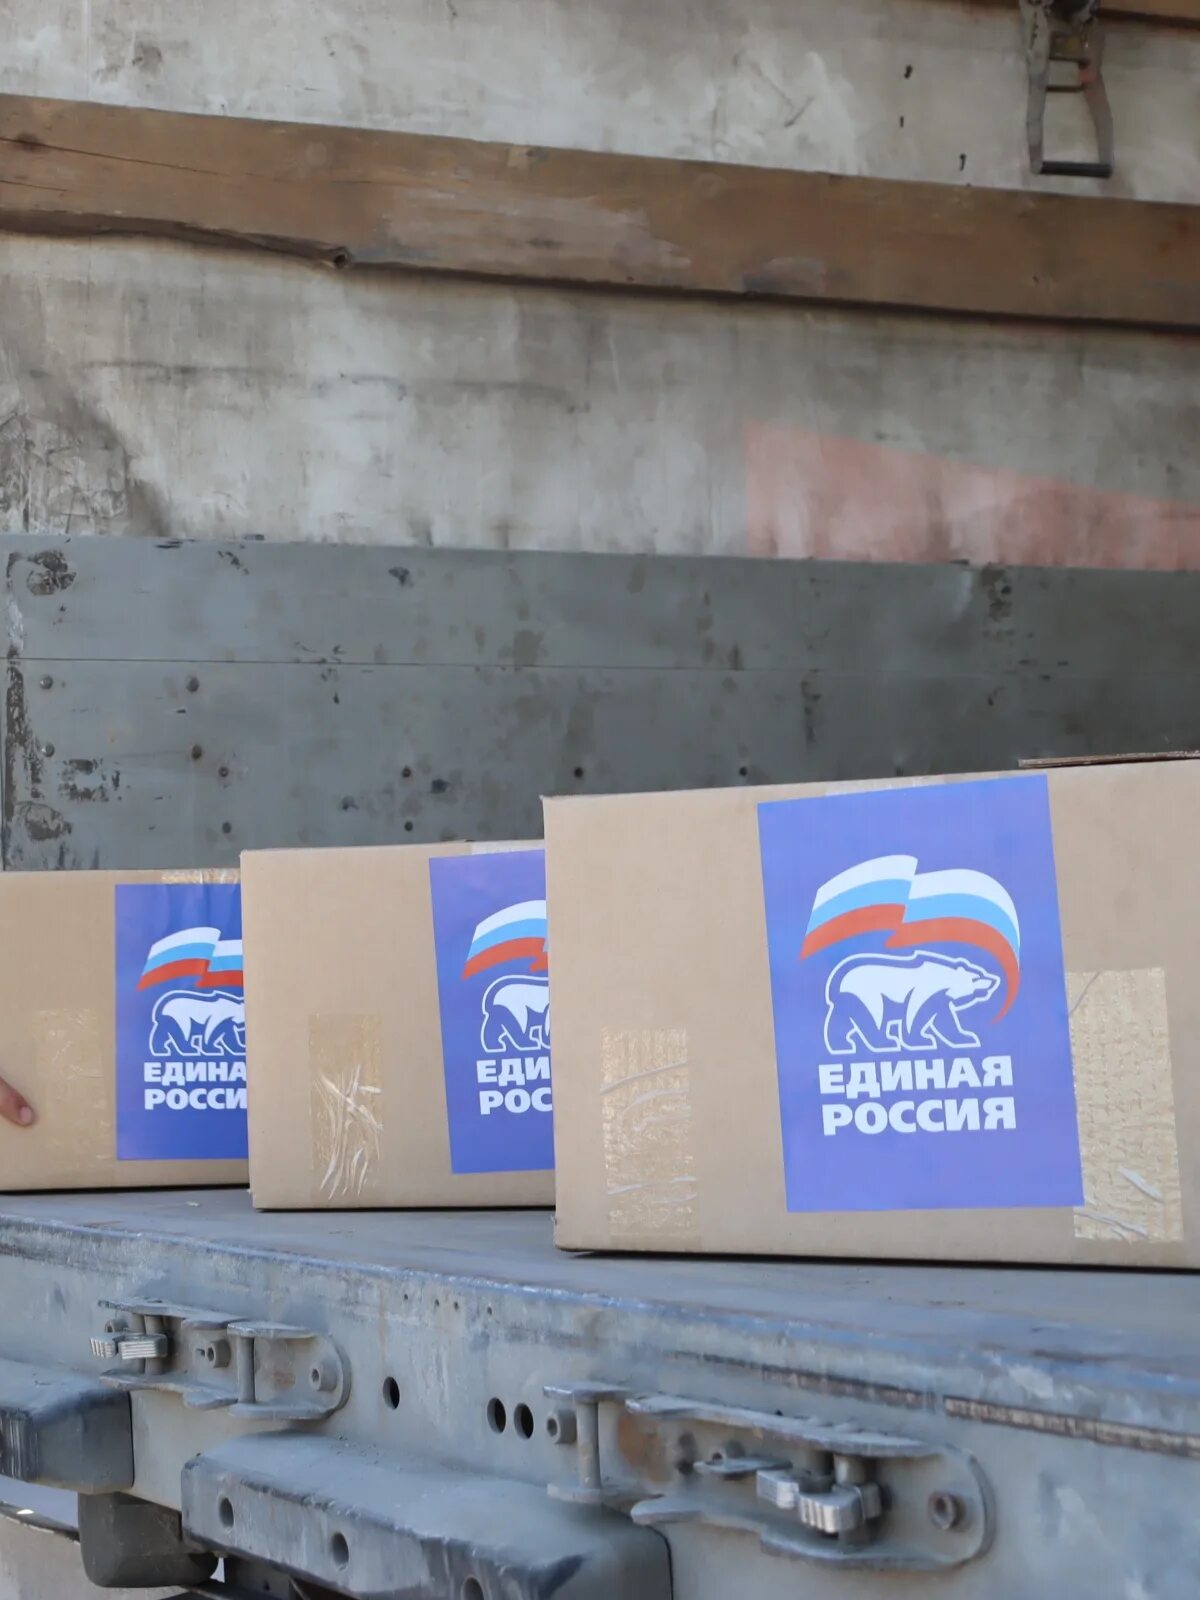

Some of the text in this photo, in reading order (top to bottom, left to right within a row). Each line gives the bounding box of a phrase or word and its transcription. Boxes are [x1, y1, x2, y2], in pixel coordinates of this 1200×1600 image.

[143, 1061, 247, 1086] ЕДИНА
[476, 1056, 551, 1087] ЕДИ
[818, 1055, 1014, 1099] ЕДИНАЯ
[144, 1087, 248, 1110] РОССИ
[479, 1087, 553, 1115] РОС
[822, 1096, 1017, 1136] РОССИЯ
